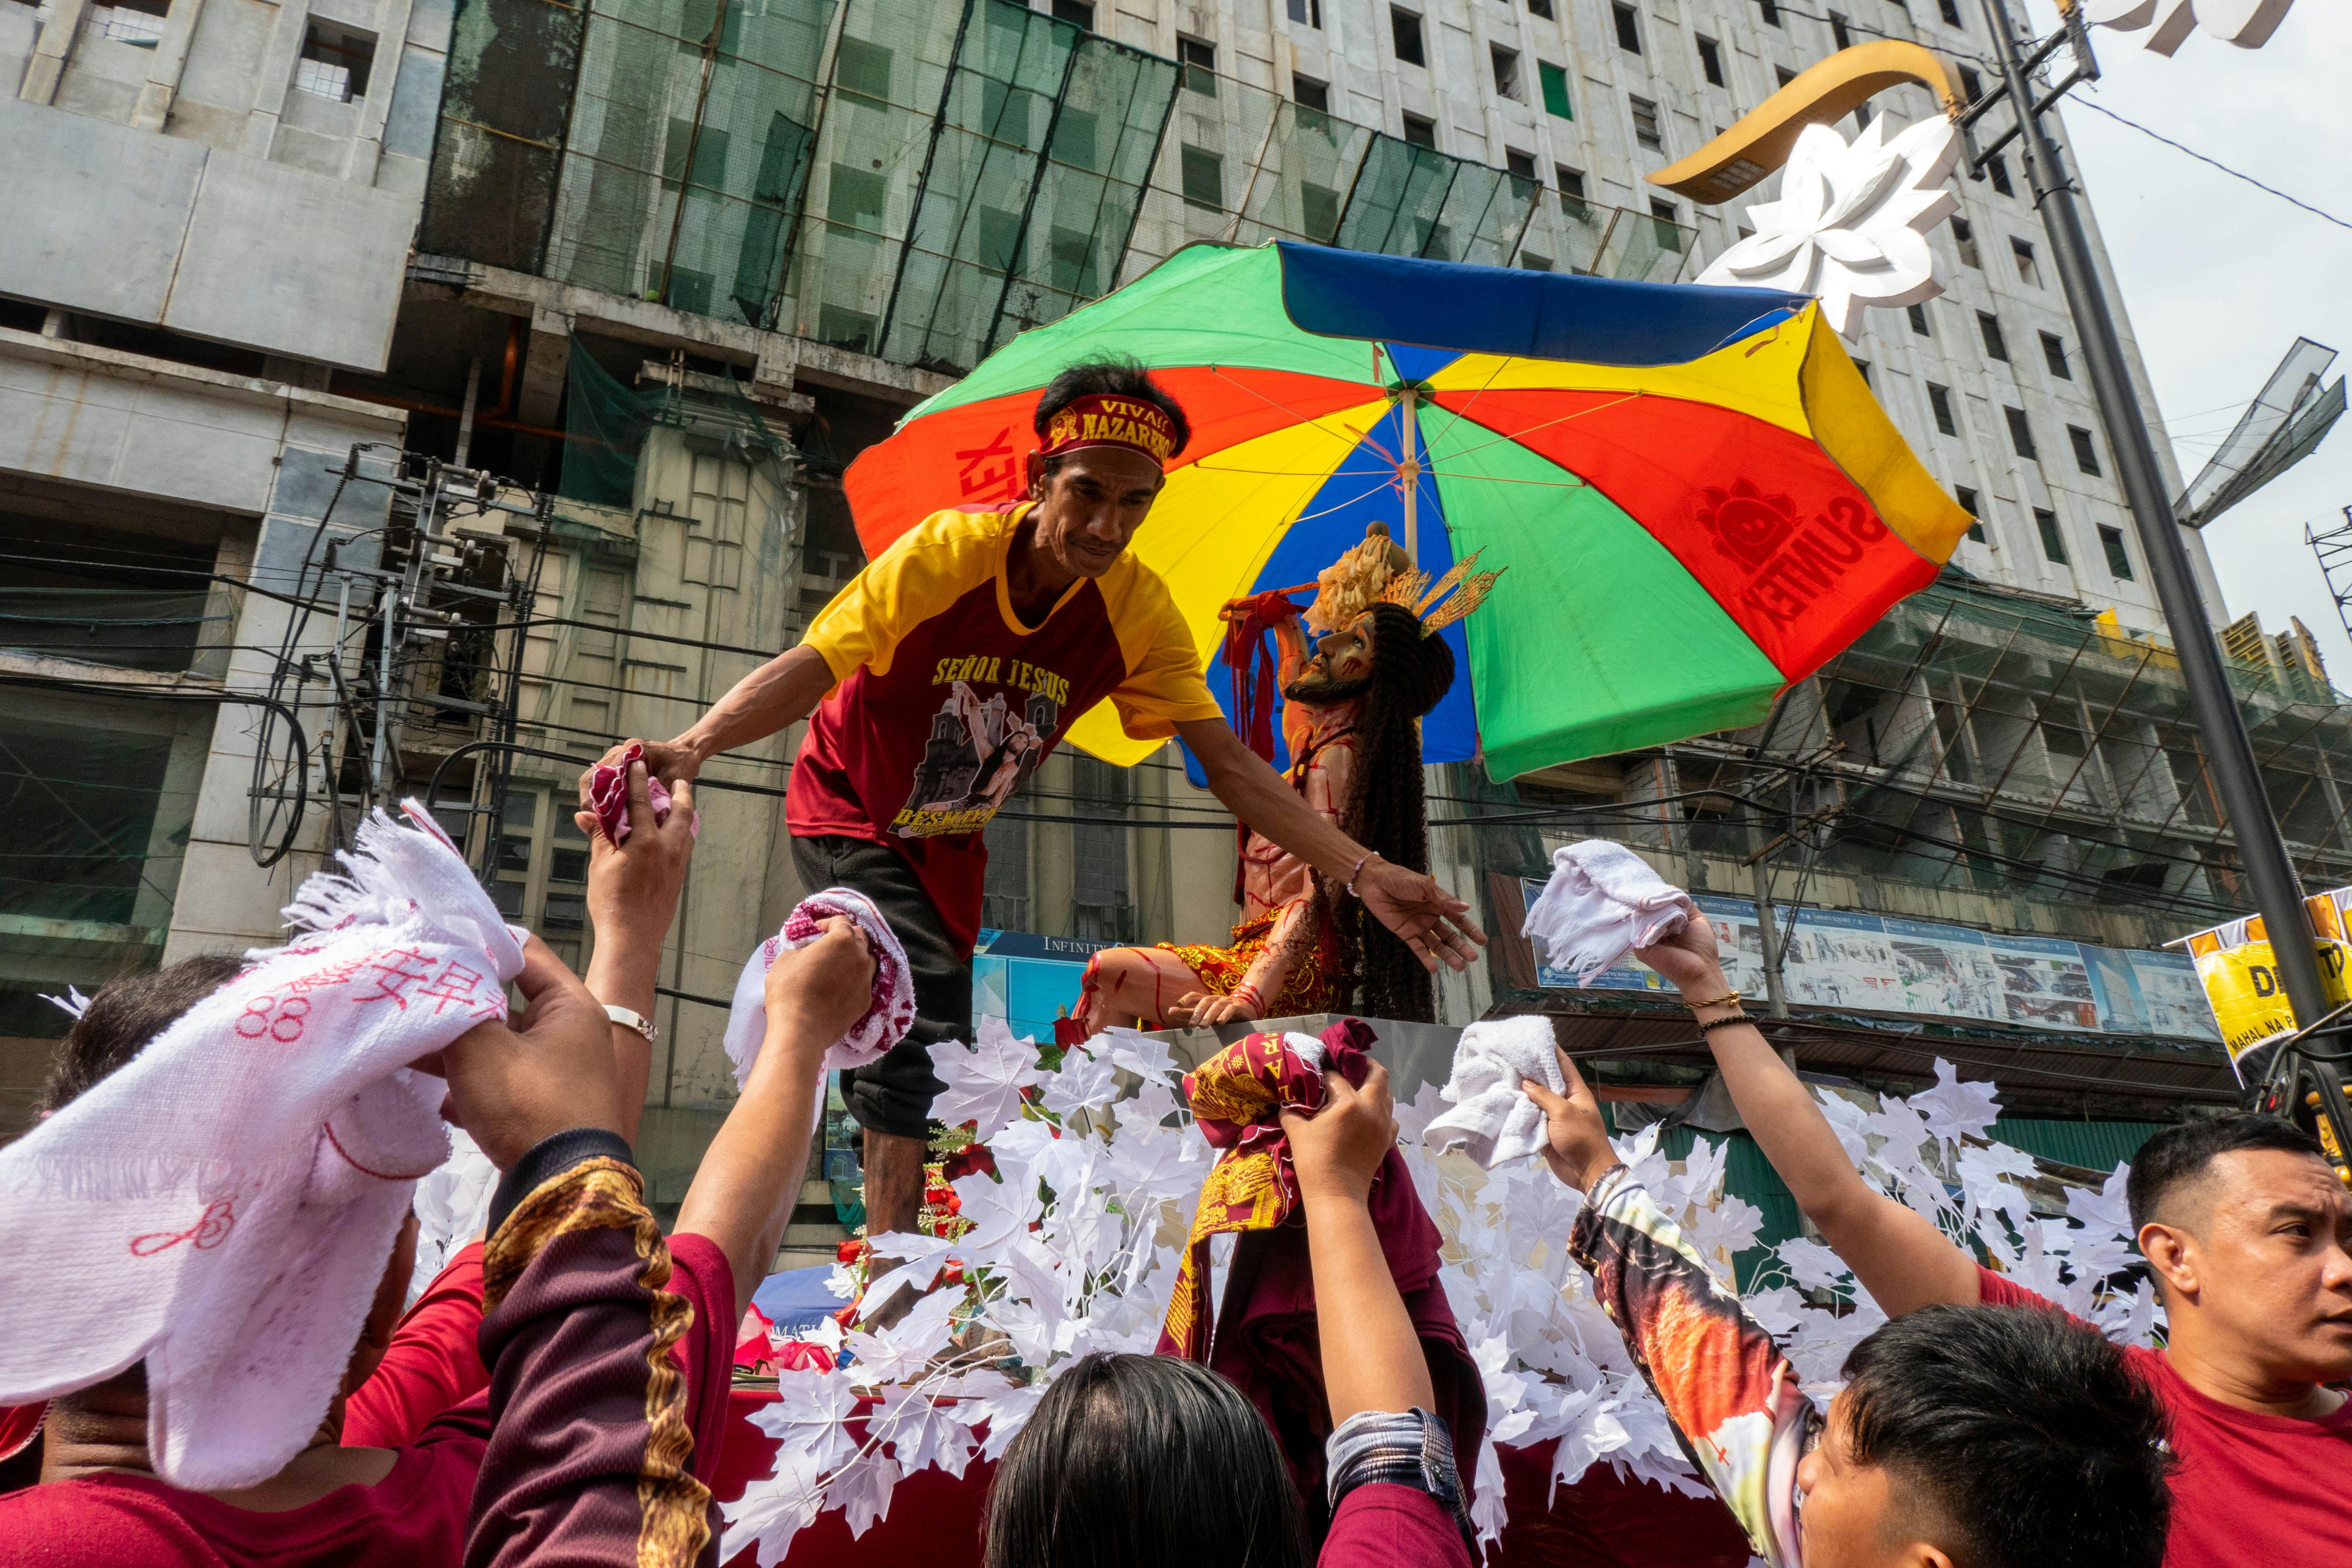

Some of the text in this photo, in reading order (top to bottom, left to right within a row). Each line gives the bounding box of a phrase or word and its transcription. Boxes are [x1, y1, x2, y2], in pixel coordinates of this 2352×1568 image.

[932, 655, 1069, 707] SEÑOR JESUS
[1043, 936, 1107, 954] INFINITY
[2230, 1026, 2265, 1054] MAHAL
[2264, 1018, 2284, 1032] NA
